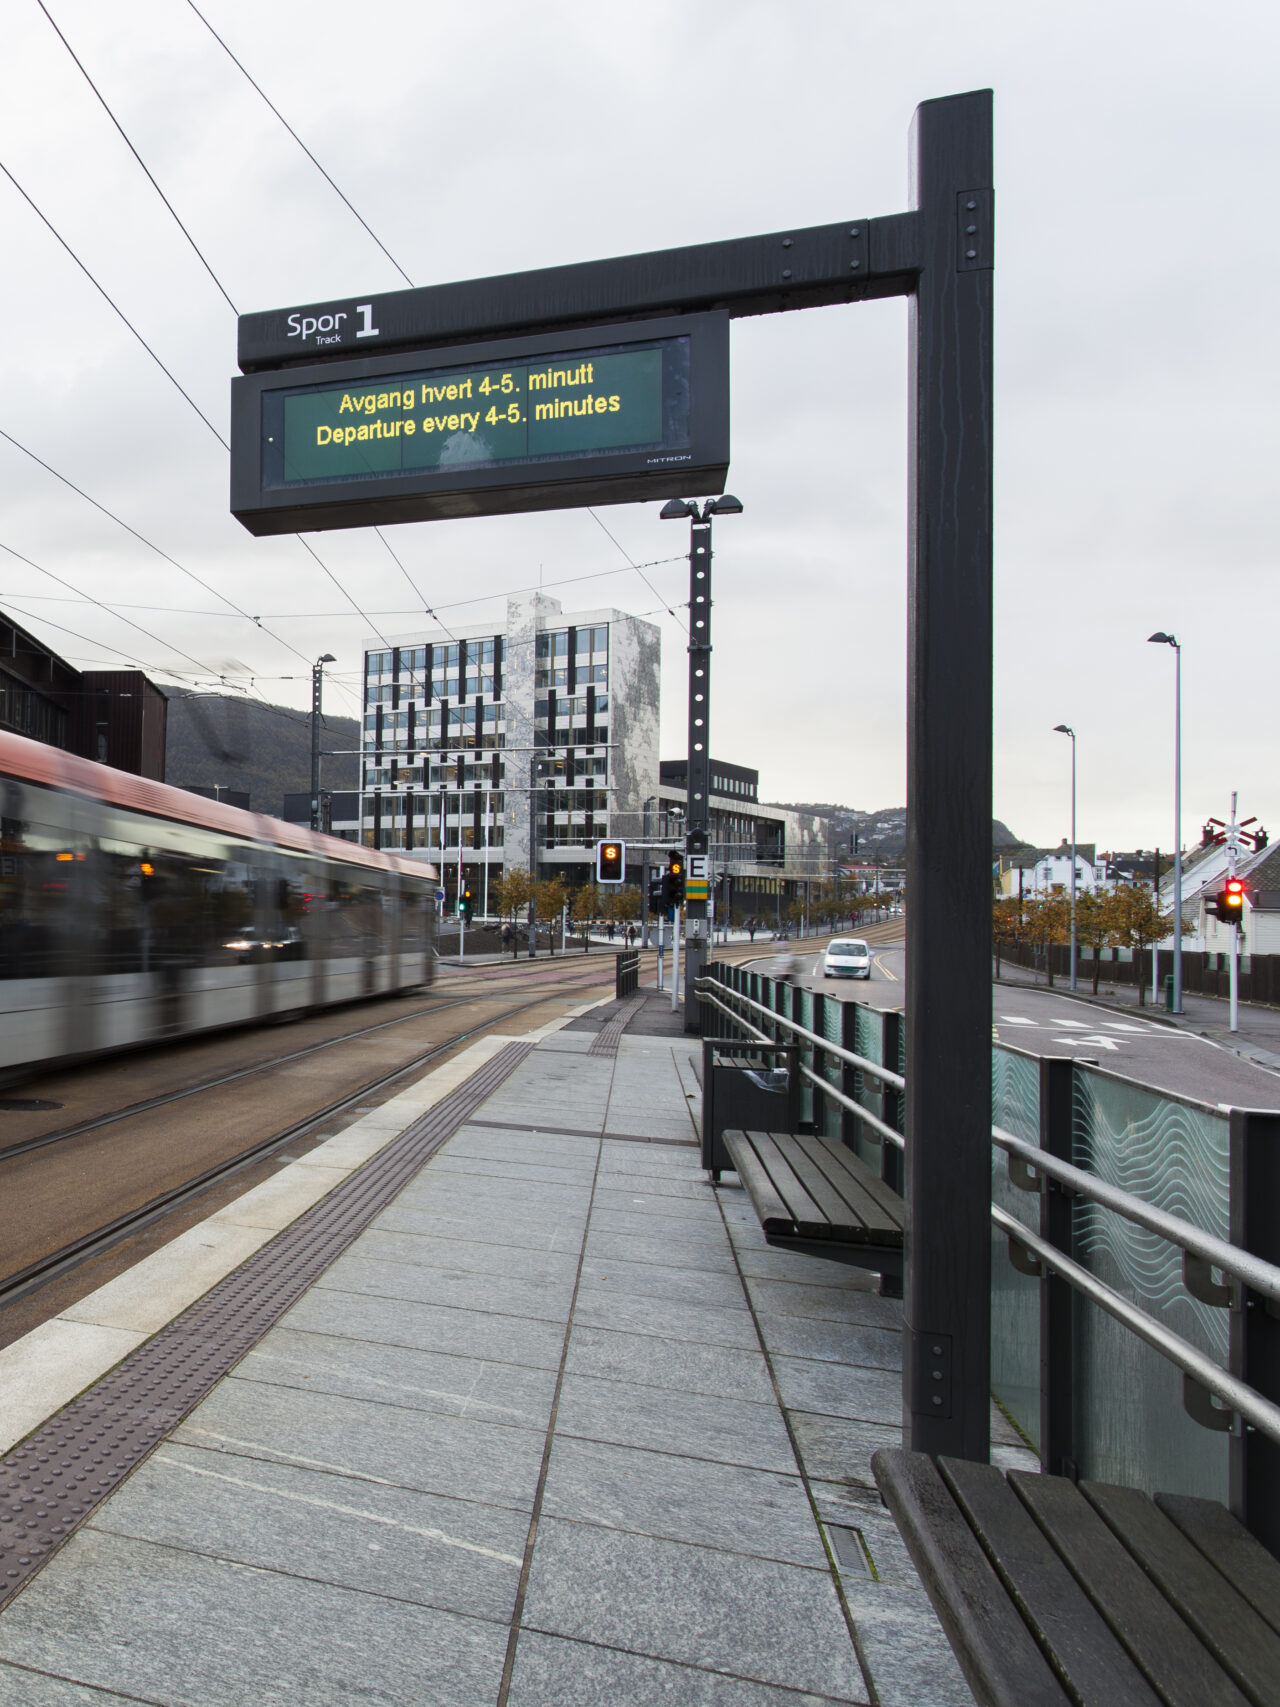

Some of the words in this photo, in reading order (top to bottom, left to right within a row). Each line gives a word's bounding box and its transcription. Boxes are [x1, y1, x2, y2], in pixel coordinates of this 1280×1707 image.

[287, 312, 347, 340] Spor
[356, 304, 379, 338] 1
[315, 334, 341, 345] Track
[338, 389, 415, 415] Avgang
[421, 378, 472, 404] hvert
[478, 373, 521, 397] 4-5.
[528, 363, 594, 391] minutt
[316, 419, 416, 446] Departure
[422, 411, 480, 433] every
[485, 403, 527, 426] 4-5.
[535, 394, 621, 421] minutes
[646, 455, 692, 464] MITRON
[690, 857, 705, 878] E
